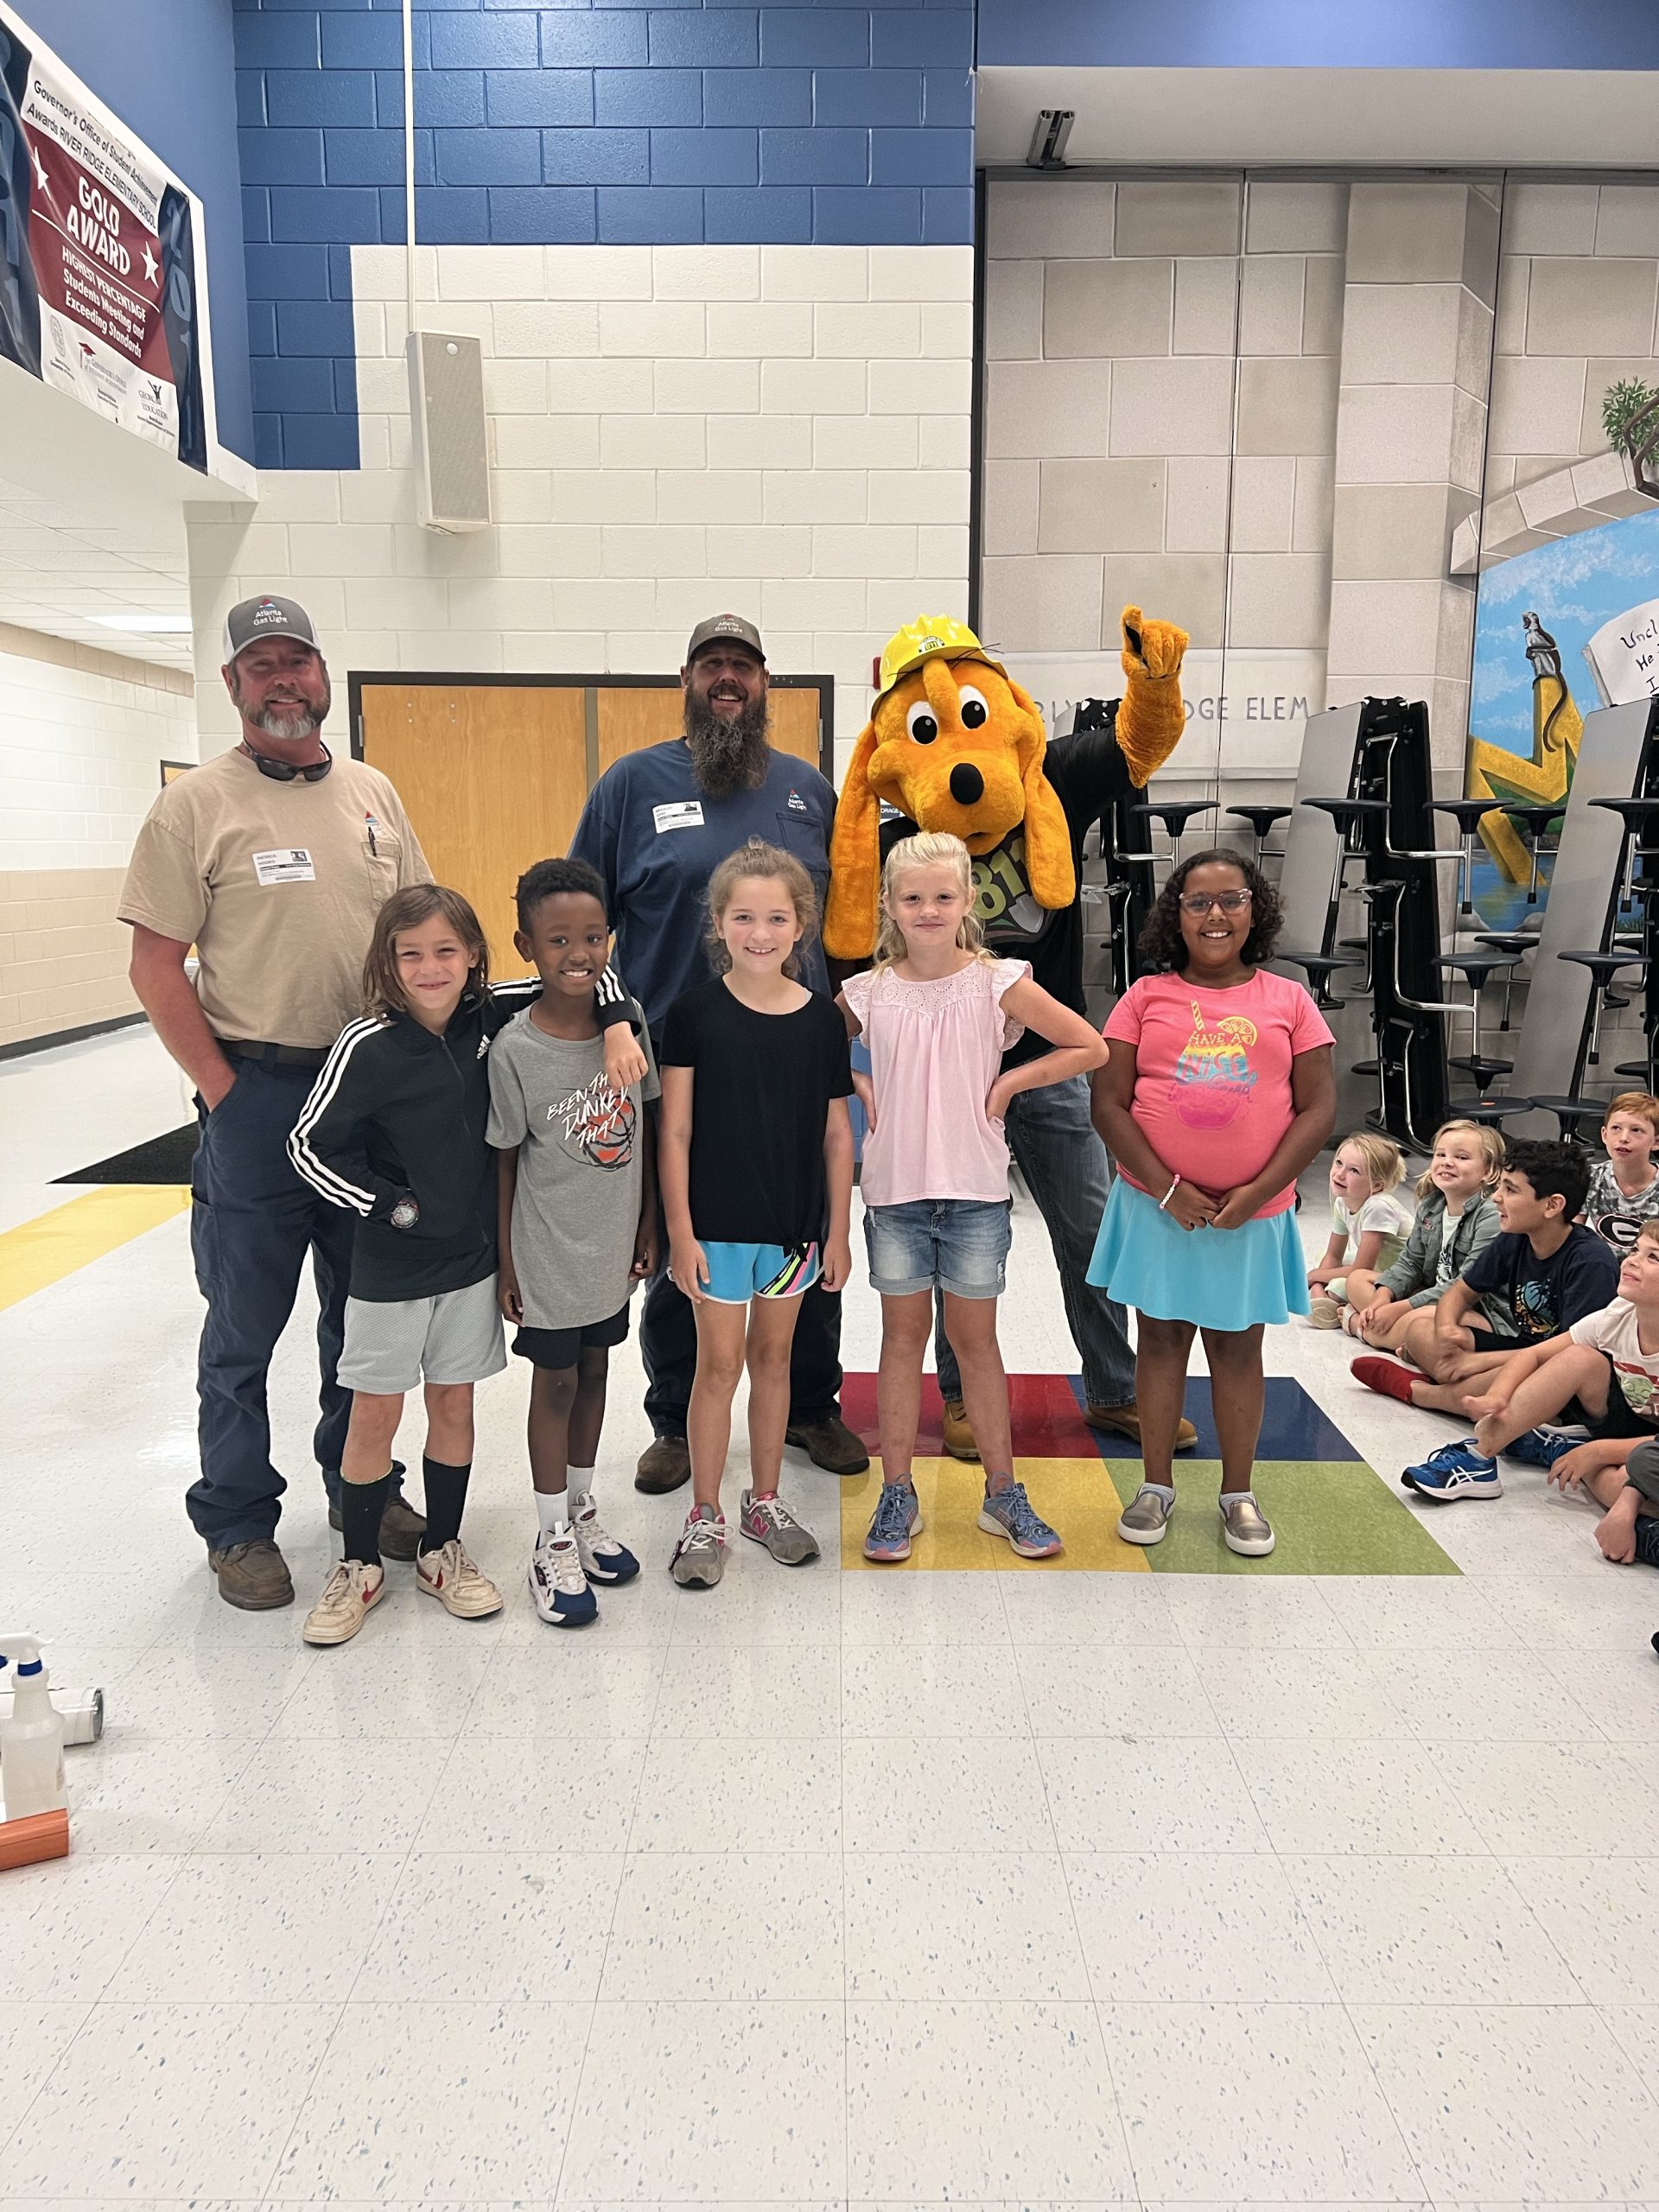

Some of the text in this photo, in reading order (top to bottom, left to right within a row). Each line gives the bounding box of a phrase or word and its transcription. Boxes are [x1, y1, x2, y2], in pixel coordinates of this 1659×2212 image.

[34, 79, 157, 208] Governor's Office of Student Achievement
[27, 103, 156, 230] Awards RIVER RIDGE ELEMENTARY SCHOOL
[79, 175, 120, 238] GOLD
[67, 204, 130, 276] AWARD
[62, 245, 146, 323] HIGHEST PERCENTAGE
[63, 268, 145, 340] Students Meeting and
[66, 289, 142, 359] Exceeding Standards
[253, 617, 268, 626] Gas
[255, 609, 283, 619] Atlanta
[1620, 619, 1658, 649] Uncl
[1636, 654, 1655, 672] He
[1246, 696, 1310, 721] ELEM
[1188, 1031, 1242, 1045] HAVE A
[546, 1087, 588, 1121] BEEN
[576, 1109, 619, 1149] THAT
